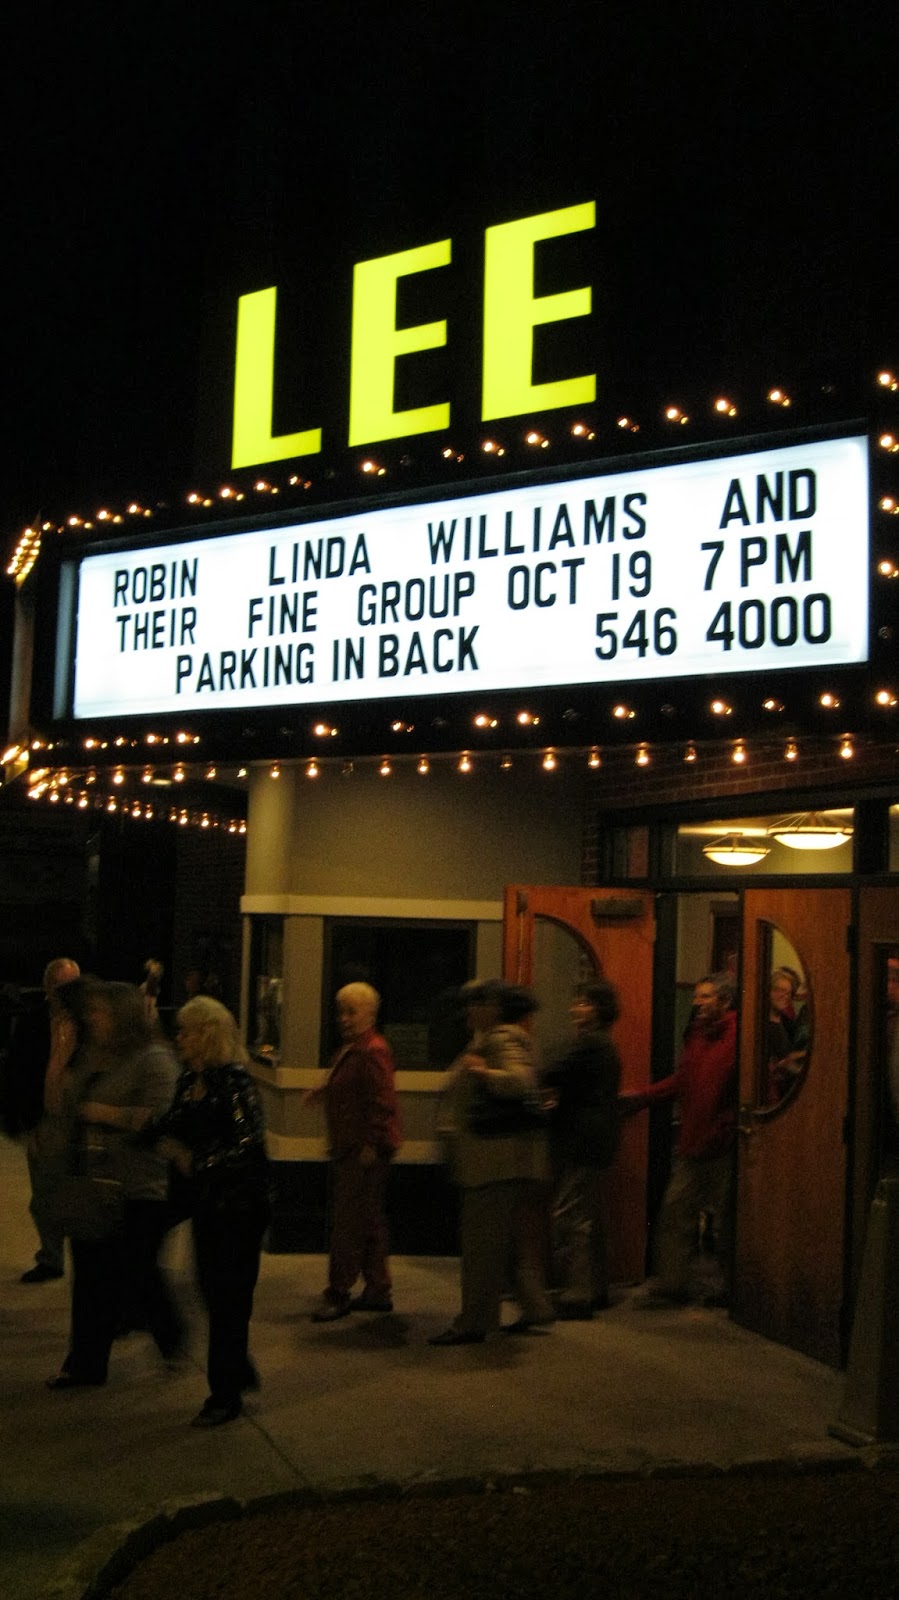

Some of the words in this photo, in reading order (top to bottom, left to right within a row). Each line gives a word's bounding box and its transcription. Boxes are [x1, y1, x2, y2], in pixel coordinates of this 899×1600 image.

[232, 201, 597, 469] LEE
[114, 558, 198, 607] ROBIN
[269, 534, 371, 586] LINDA
[428, 493, 647, 565] WILLIAMS
[720, 468, 817, 529] AND
[116, 607, 197, 652] THEIR
[249, 591, 318, 638] FINE
[358, 571, 475, 626] GROUP
[508, 558, 585, 611] OCT
[613, 551, 652, 600] 19
[701, 541, 725, 591] 7
[740, 531, 812, 587] PM
[176, 643, 314, 694] PARKING
[333, 637, 365, 682] IN
[379, 626, 480, 678] BACK
[596, 608, 678, 660] 546
[707, 593, 832, 651] 4000
